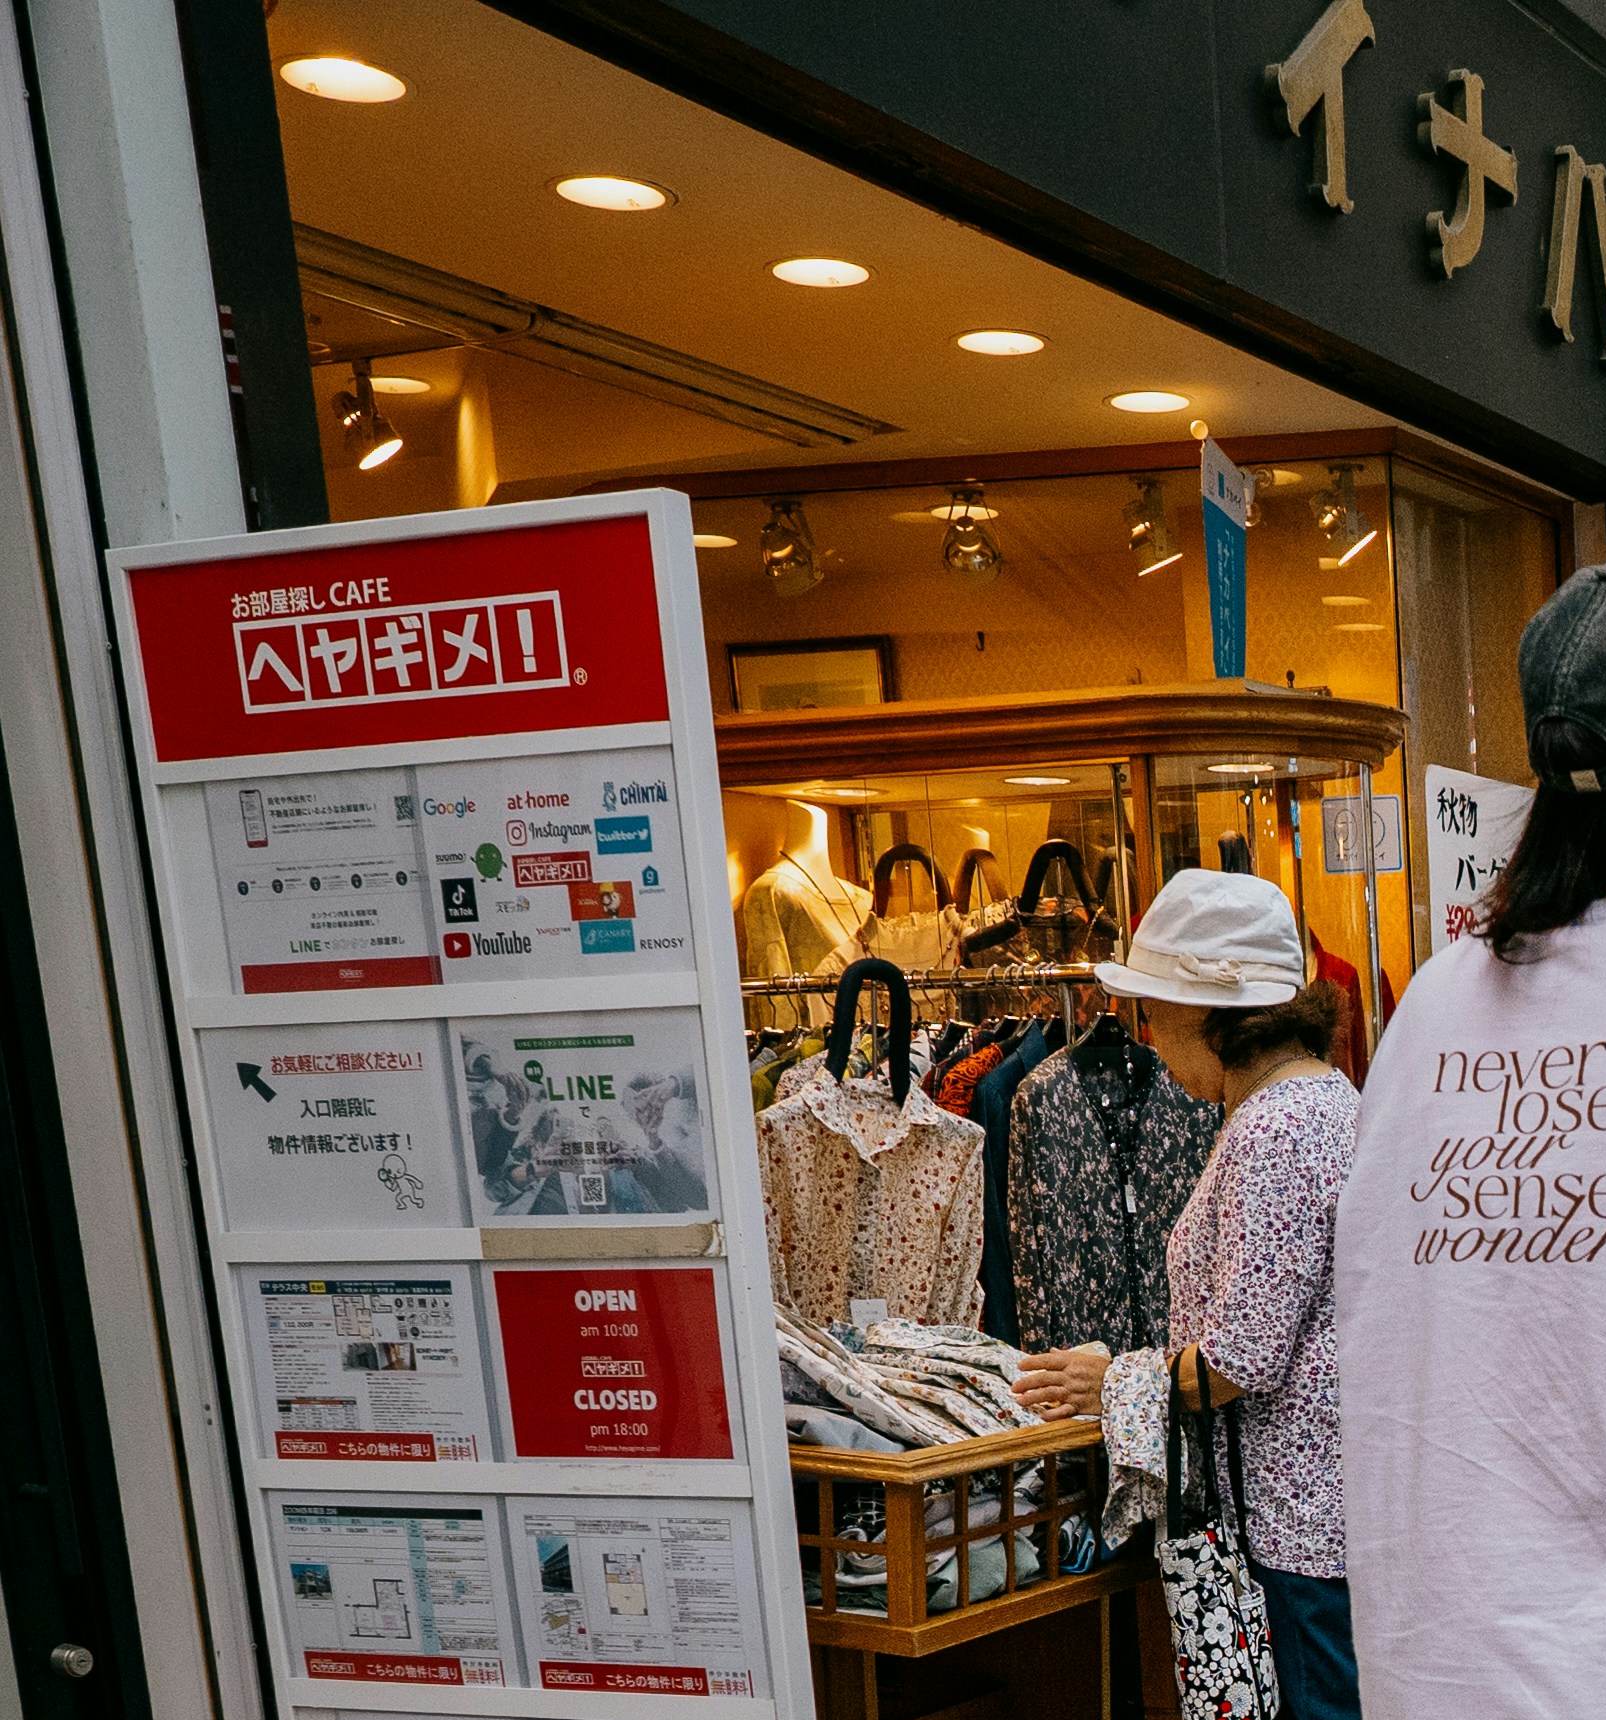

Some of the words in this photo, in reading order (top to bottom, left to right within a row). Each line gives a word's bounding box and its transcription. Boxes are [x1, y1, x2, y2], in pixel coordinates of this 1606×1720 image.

[231, 589, 325, 619] お部屋探し
[329, 578, 392, 608] CAFE
[244, 605, 545, 697] ヘヤギメ!
[526, 791, 570, 810] home
[619, 780, 668, 805] CHINTAI
[423, 796, 476, 818] Google
[1436, 787, 1478, 838] 秋物
[529, 821, 592, 844] Instagram
[597, 831, 636, 843] twitter
[472, 931, 532, 956] YouTube
[640, 938, 684, 950] RENOSY
[271, 1052, 423, 1074] お気軽にご相談ください!
[547, 1075, 616, 1101] LINE
[300, 1098, 377, 1118] 入口階段に
[579, 1106, 590, 1118] で
[268, 1133, 412, 1155] 物件情報ございます!
[1411, 1131, 1574, 1203] your
[574, 1290, 637, 1311] OPEN
[581, 1326, 600, 1337] am
[603, 1324, 638, 1337] 10:00
[574, 1390, 657, 1410] CLOSED
[590, 1424, 610, 1438] pm
[614, 1423, 648, 1436] 18:00
